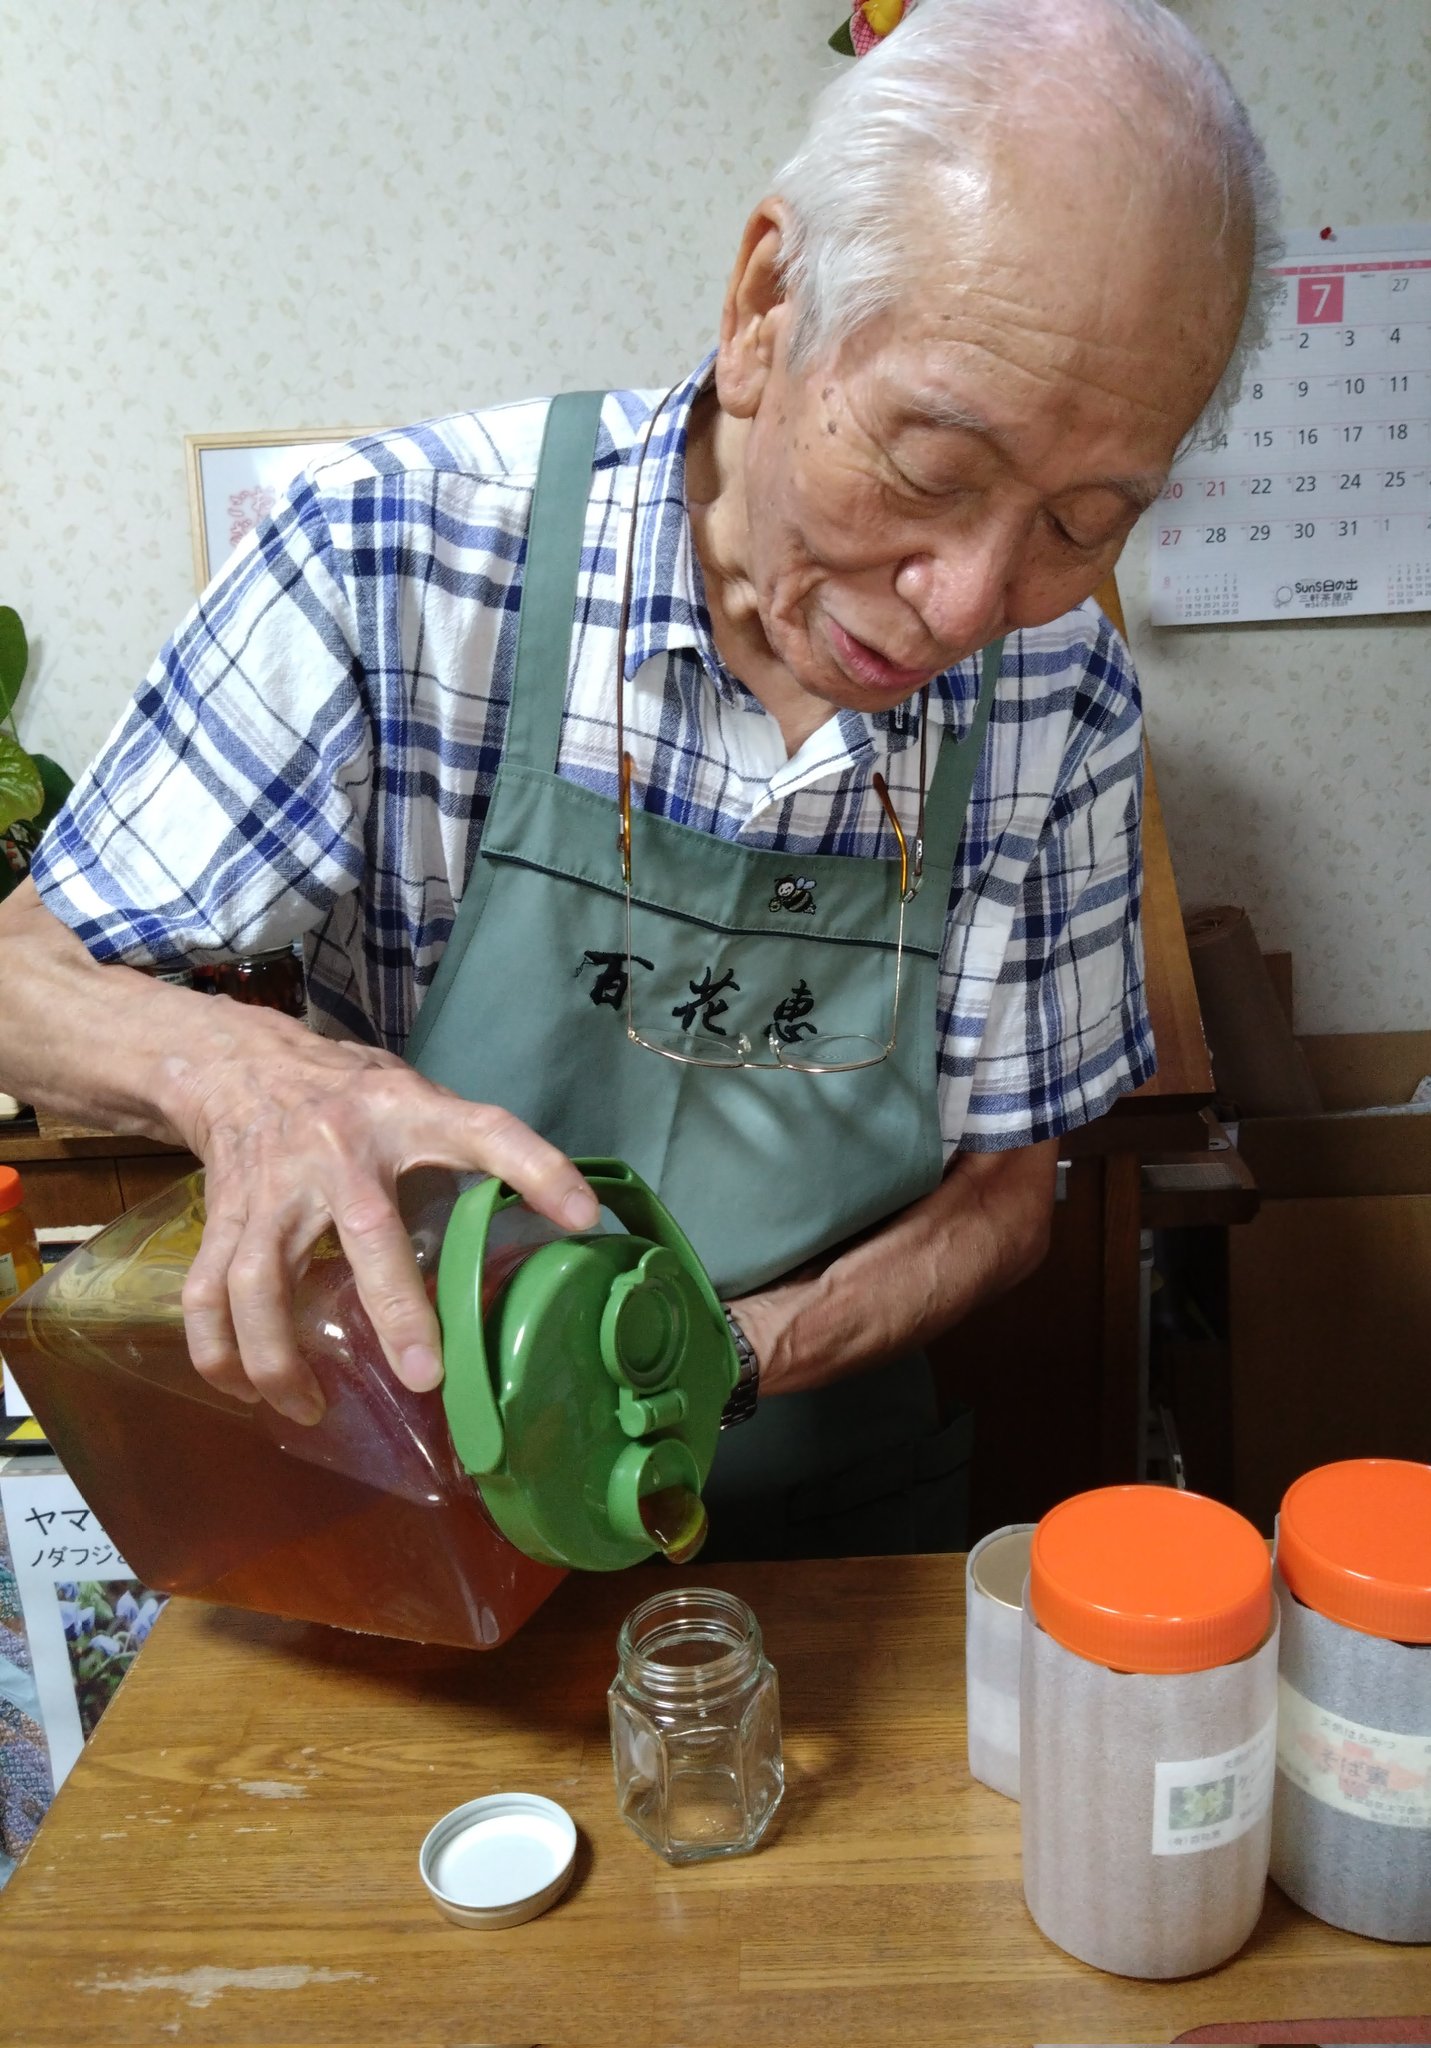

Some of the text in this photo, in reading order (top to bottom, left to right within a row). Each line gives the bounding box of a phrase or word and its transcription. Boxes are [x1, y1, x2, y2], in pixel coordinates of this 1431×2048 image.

[1311, 284, 1331, 318] 7
[1392, 278, 1409, 292] 27
[1299, 328, 1400, 349] 2 3 4
[1252, 376, 1408, 399] 8 9 10 11
[1254, 431, 1273, 447] 15
[1299, 428, 1318, 444] 16
[1344, 426, 1363, 442] 17
[1388, 424, 1408, 440] 18
[1206, 481, 1225, 497] 21
[1251, 478, 1272, 494] 22
[1295, 475, 1316, 492] 23
[1340, 473, 1361, 490] 24
[1384, 471, 1406, 487] 25
[1161, 518, 1390, 546] 27 28 29 30 31 1
[25, 1507, 107, 1536] ヤマ
